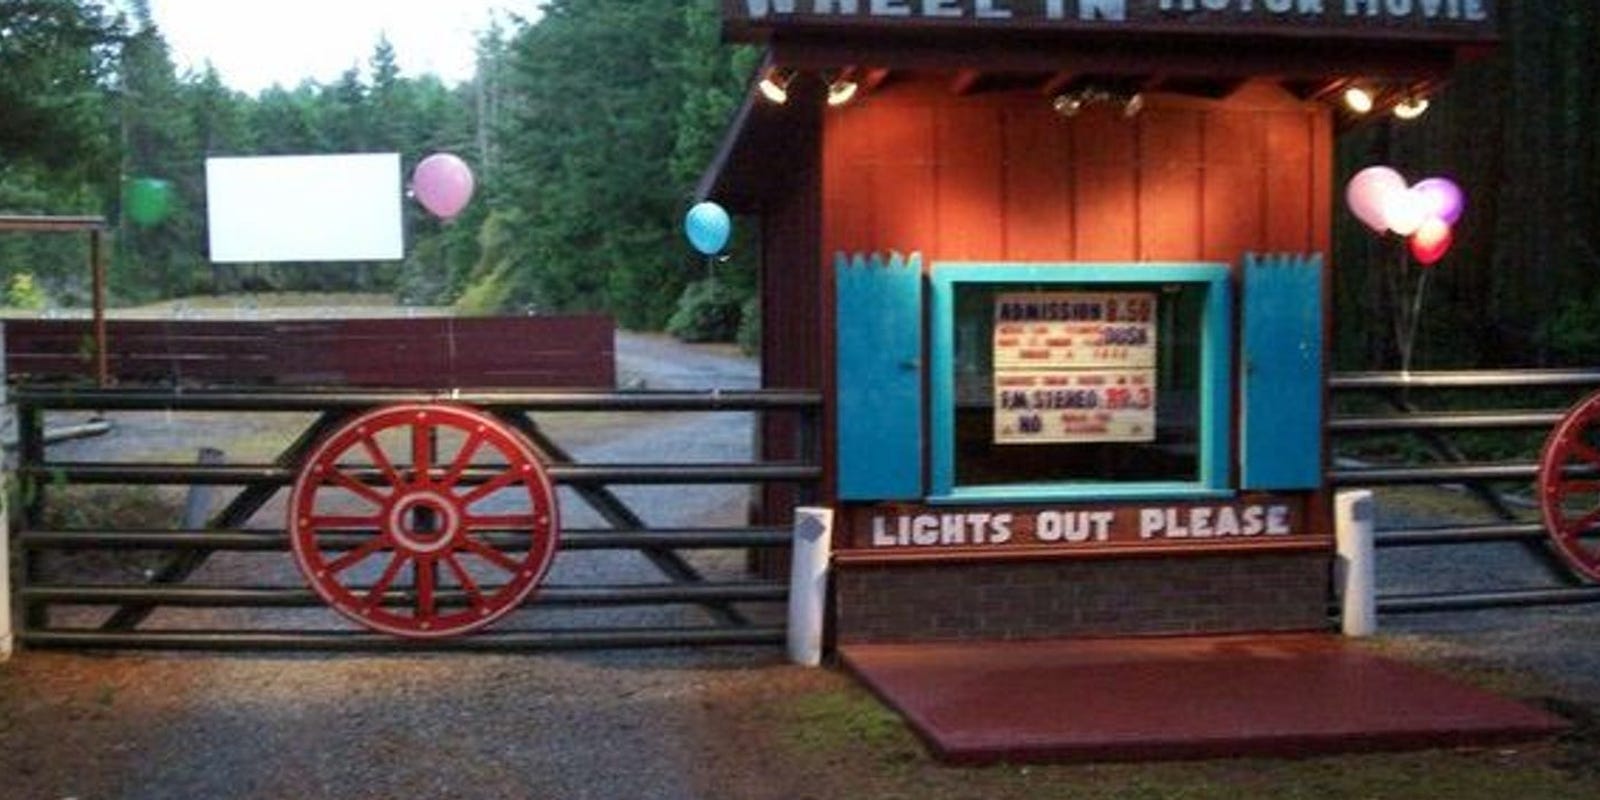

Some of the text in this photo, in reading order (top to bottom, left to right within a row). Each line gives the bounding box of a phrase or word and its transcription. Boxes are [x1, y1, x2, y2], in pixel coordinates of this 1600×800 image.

[873, 506, 1289, 545] LIGHTS OUT PLEASE
